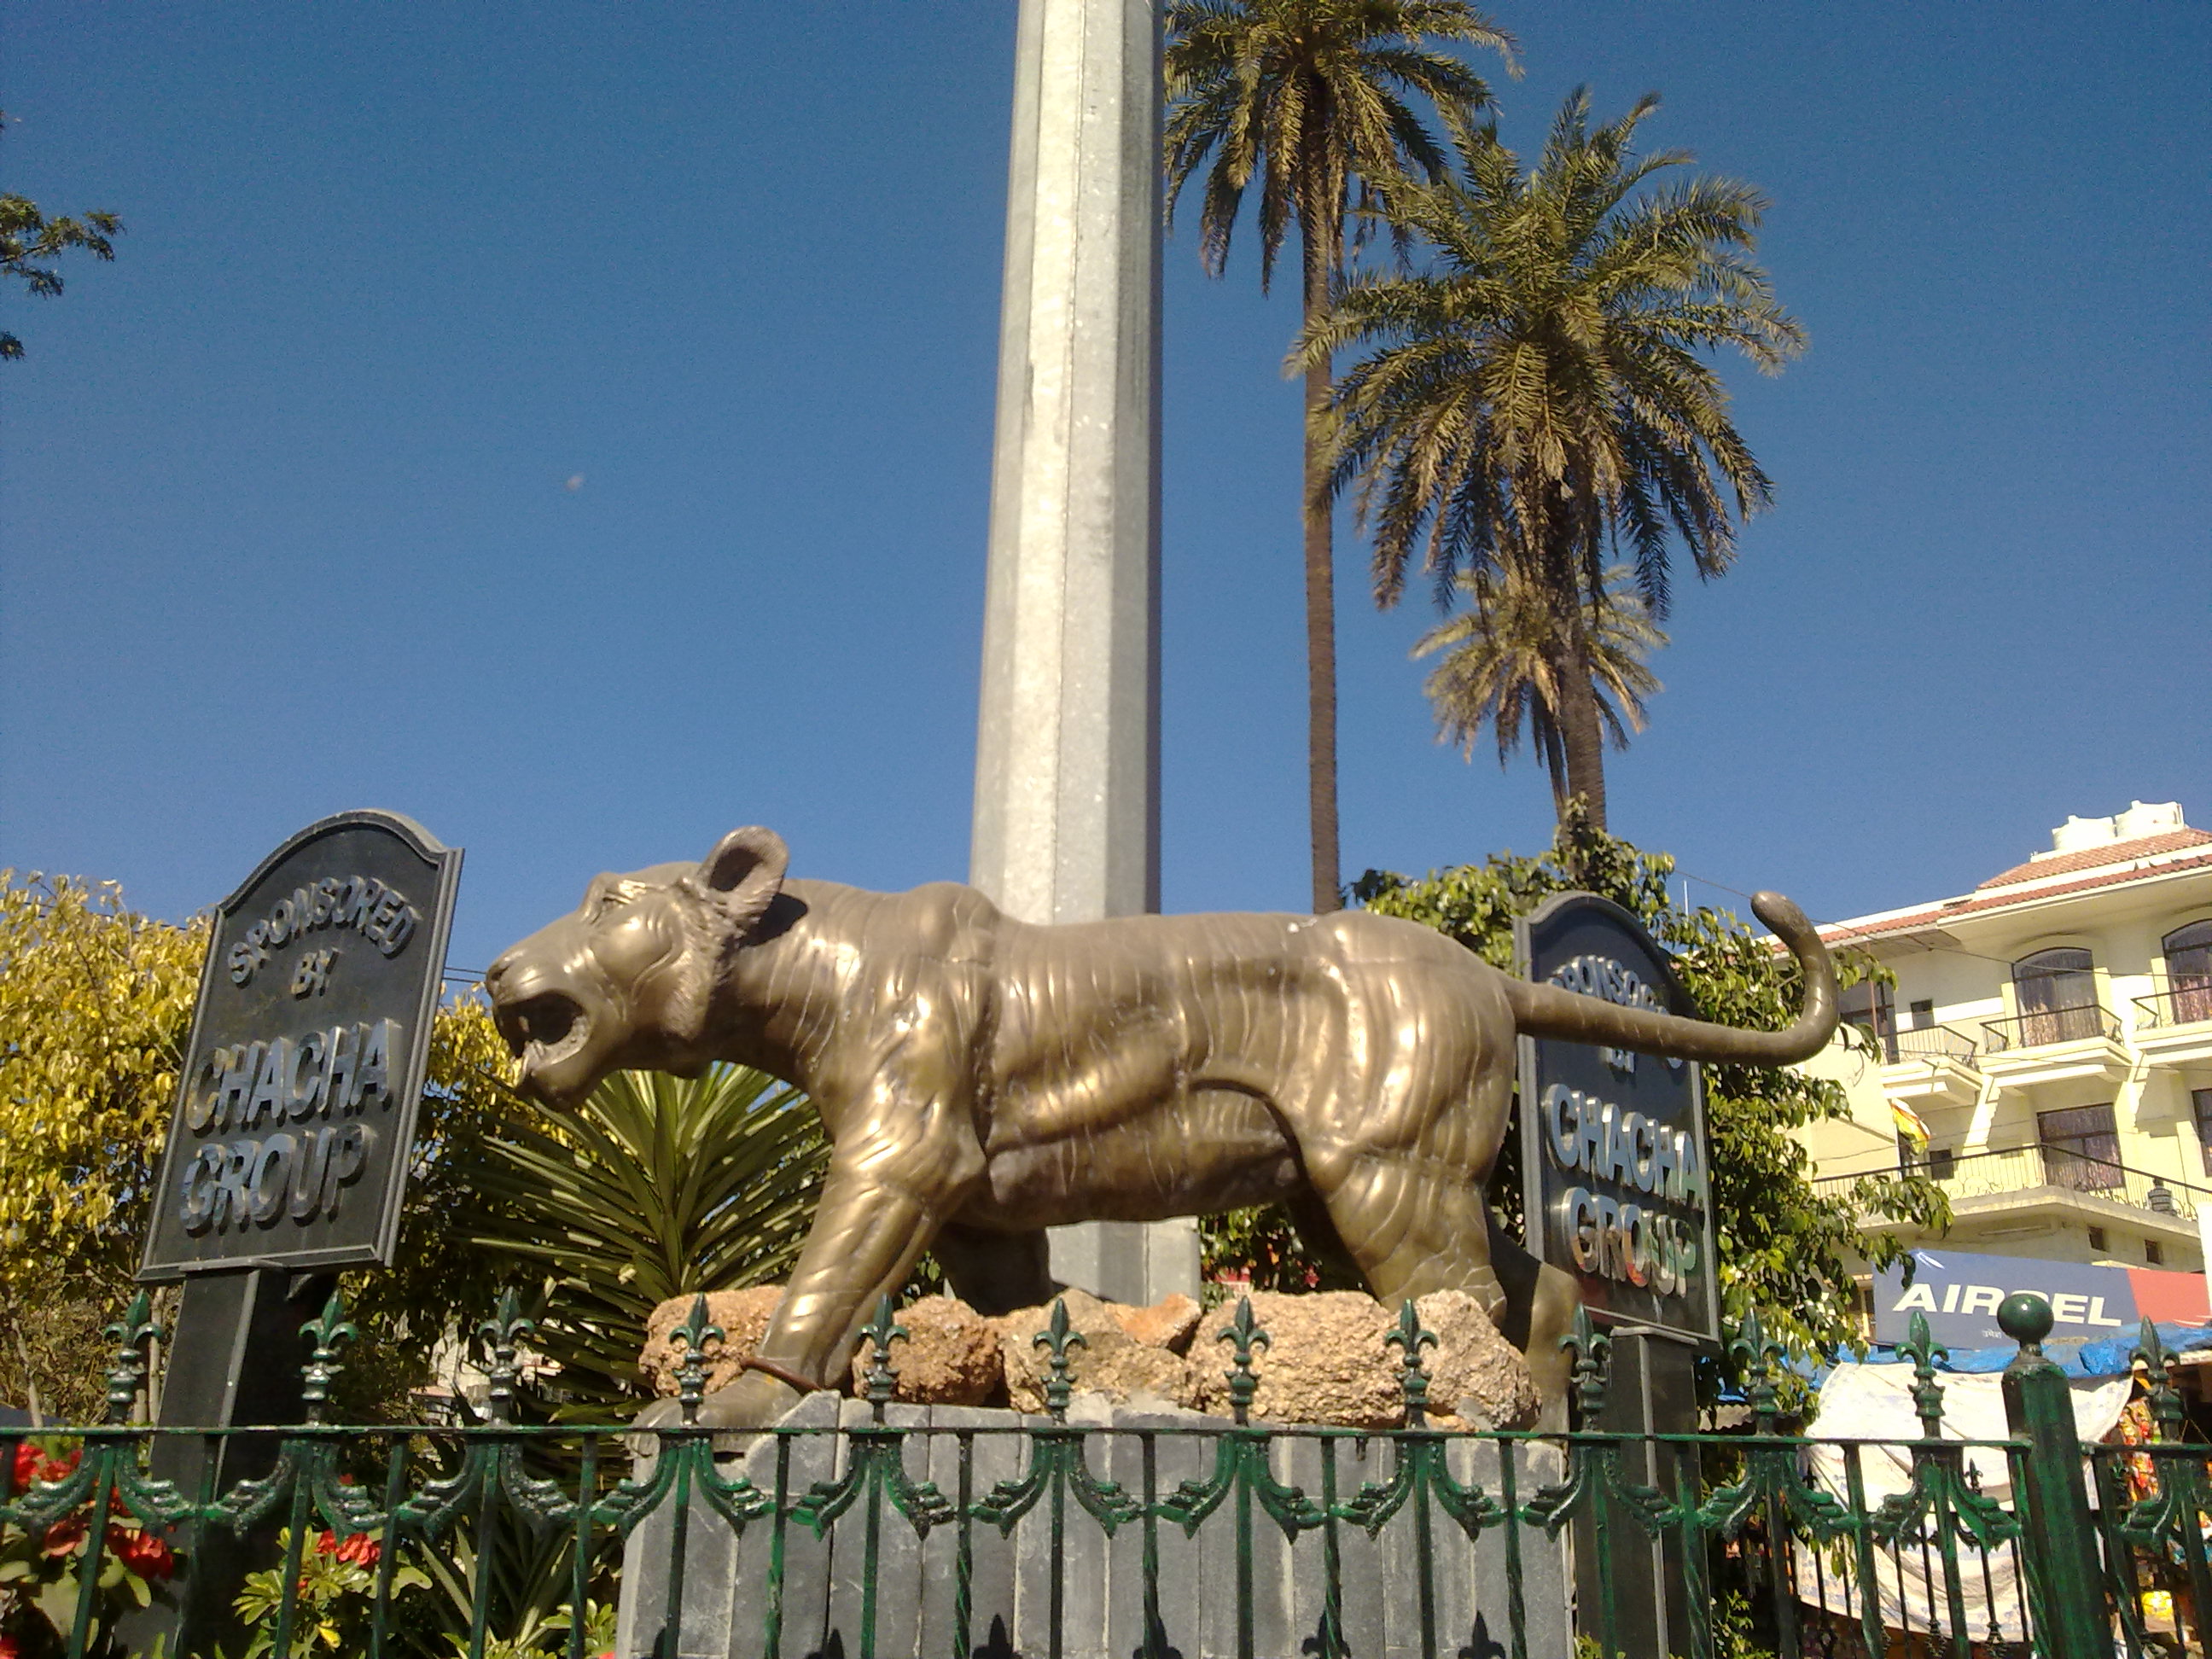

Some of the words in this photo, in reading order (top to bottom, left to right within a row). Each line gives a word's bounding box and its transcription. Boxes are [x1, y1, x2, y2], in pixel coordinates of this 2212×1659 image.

[227, 876, 421, 985] SPONSORED
[291, 947, 341, 996] BY
[185, 1018, 399, 1132] CHACHA
[179, 1123, 374, 1231] GROUP
[1544, 1083, 1703, 1210] CHACHA
[1562, 1187, 1697, 1298] GROUP
[1892, 1283, 2122, 1327] AIREL
